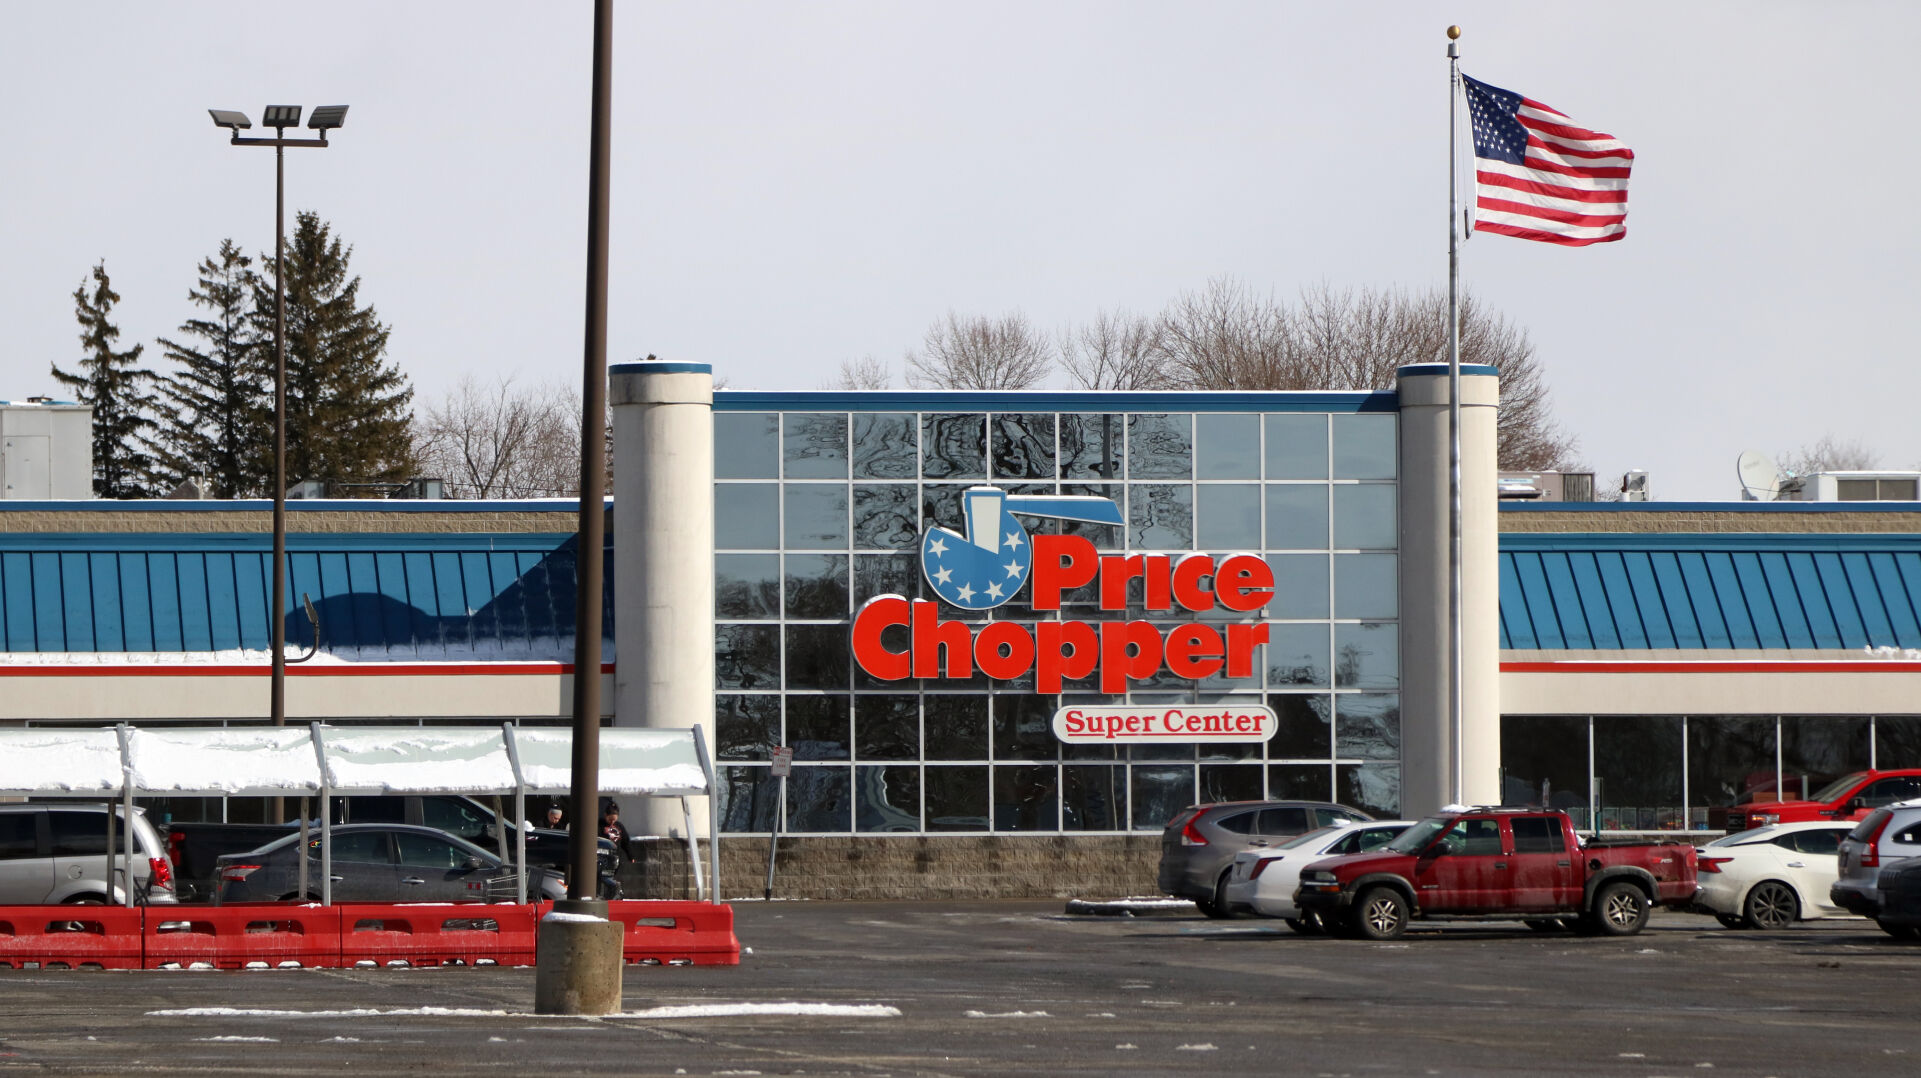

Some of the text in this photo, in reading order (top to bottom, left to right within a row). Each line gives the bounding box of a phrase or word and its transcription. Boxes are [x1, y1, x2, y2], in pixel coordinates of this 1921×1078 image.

[1031, 534, 1275, 611] Price
[851, 595, 1270, 694] Chopper
[1065, 709, 1266, 738] Super Center
